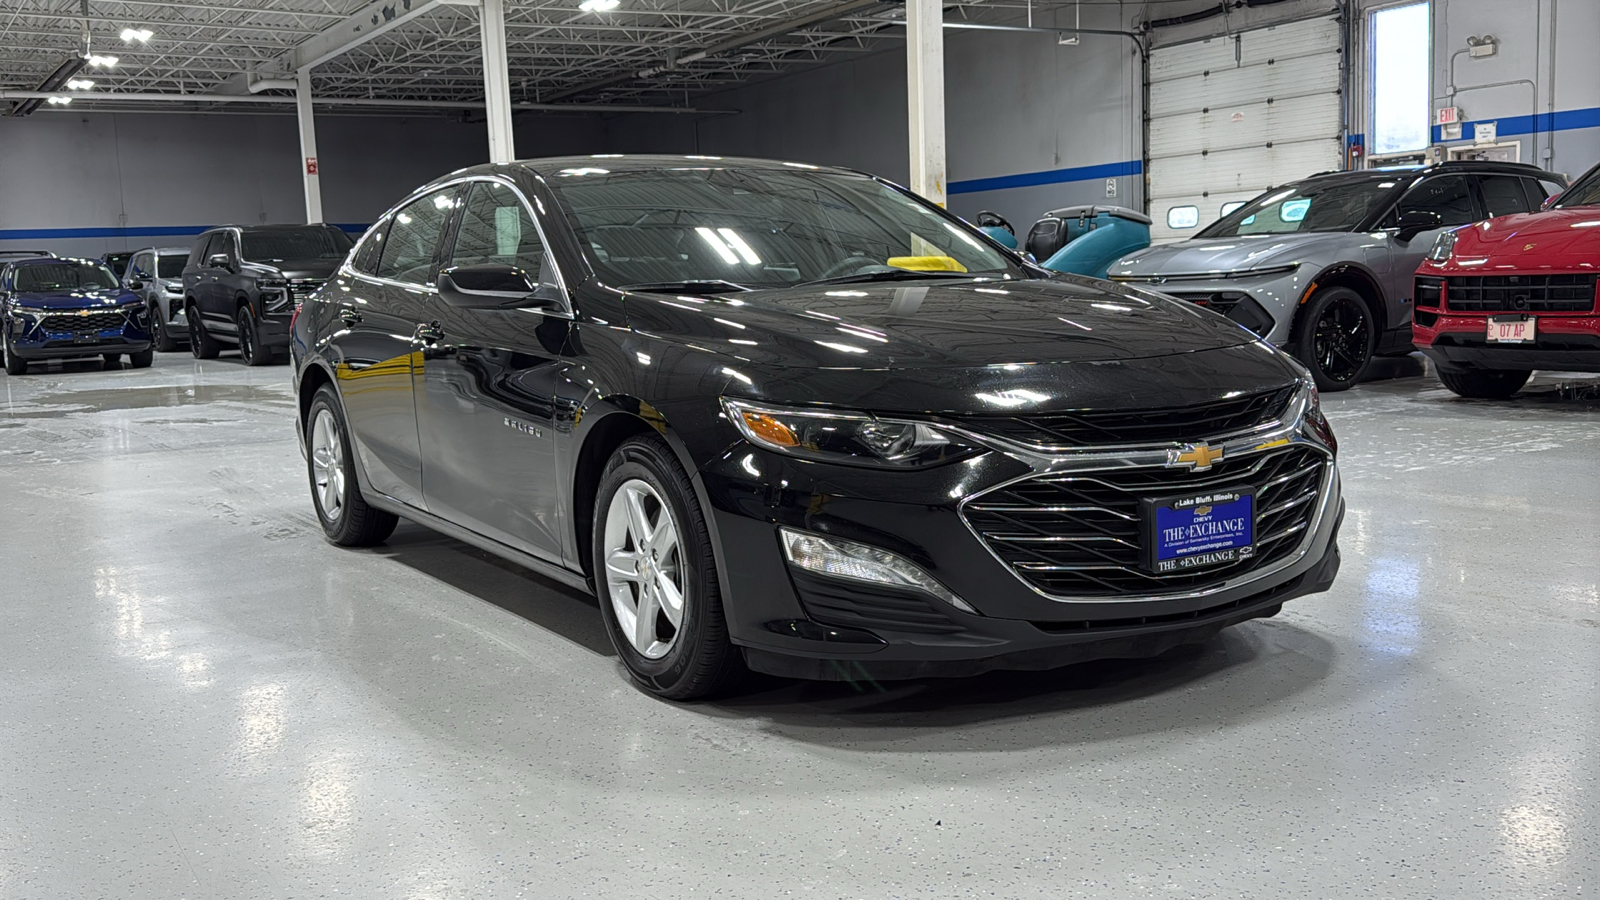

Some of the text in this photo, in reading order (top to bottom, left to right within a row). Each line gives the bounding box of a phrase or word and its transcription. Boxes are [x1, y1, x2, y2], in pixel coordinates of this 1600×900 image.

[1440, 108, 1454, 122] EXIT
[1500, 324, 1511, 337] 07
[1513, 324, 1525, 337] AP
[1179, 498, 1194, 506] Lake
[1213, 493, 1233, 501] Illinois
[1163, 518, 1244, 542] THE EXCHANGE
[1176, 540, 1233, 554] www.chevyexchange.com
[1158, 550, 1234, 571] THE EXCHANGE
